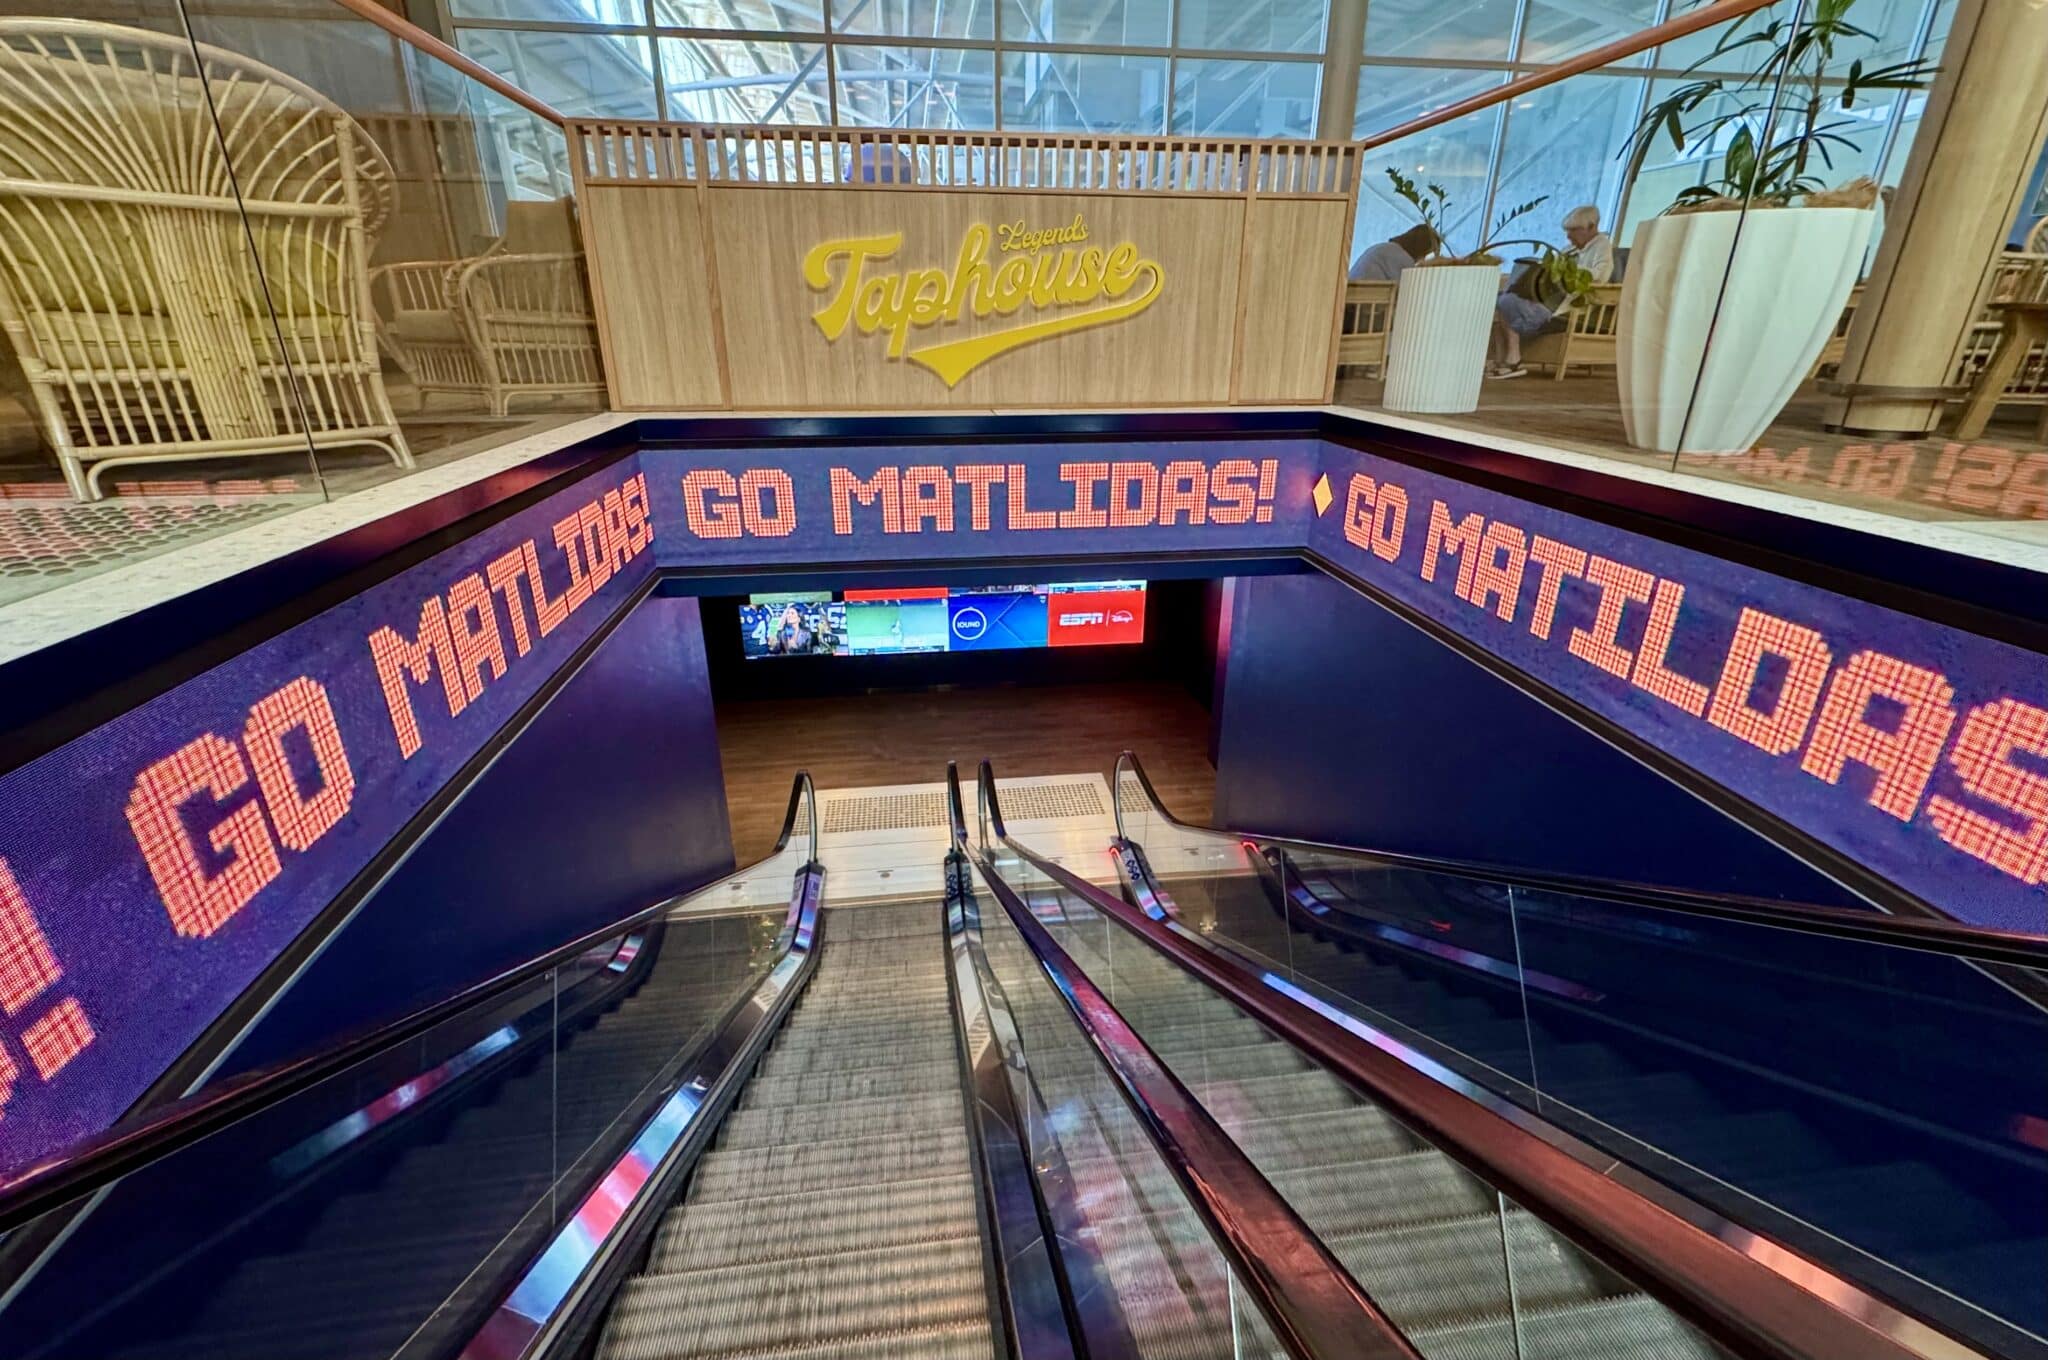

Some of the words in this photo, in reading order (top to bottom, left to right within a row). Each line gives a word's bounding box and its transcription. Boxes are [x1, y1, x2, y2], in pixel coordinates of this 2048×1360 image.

[998, 213, 1089, 255] Legends
[804, 223, 1142, 362] Taphouse
[683, 469, 795, 538] GO
[831, 459, 1278, 534] MATLIDAS!
[1059, 612, 1103, 626] ESPN
[126, 676, 354, 937] GO
[369, 473, 654, 759] MATLIDAS!
[1344, 473, 1409, 562] GO
[1421, 499, 2048, 885] MATILDAS
